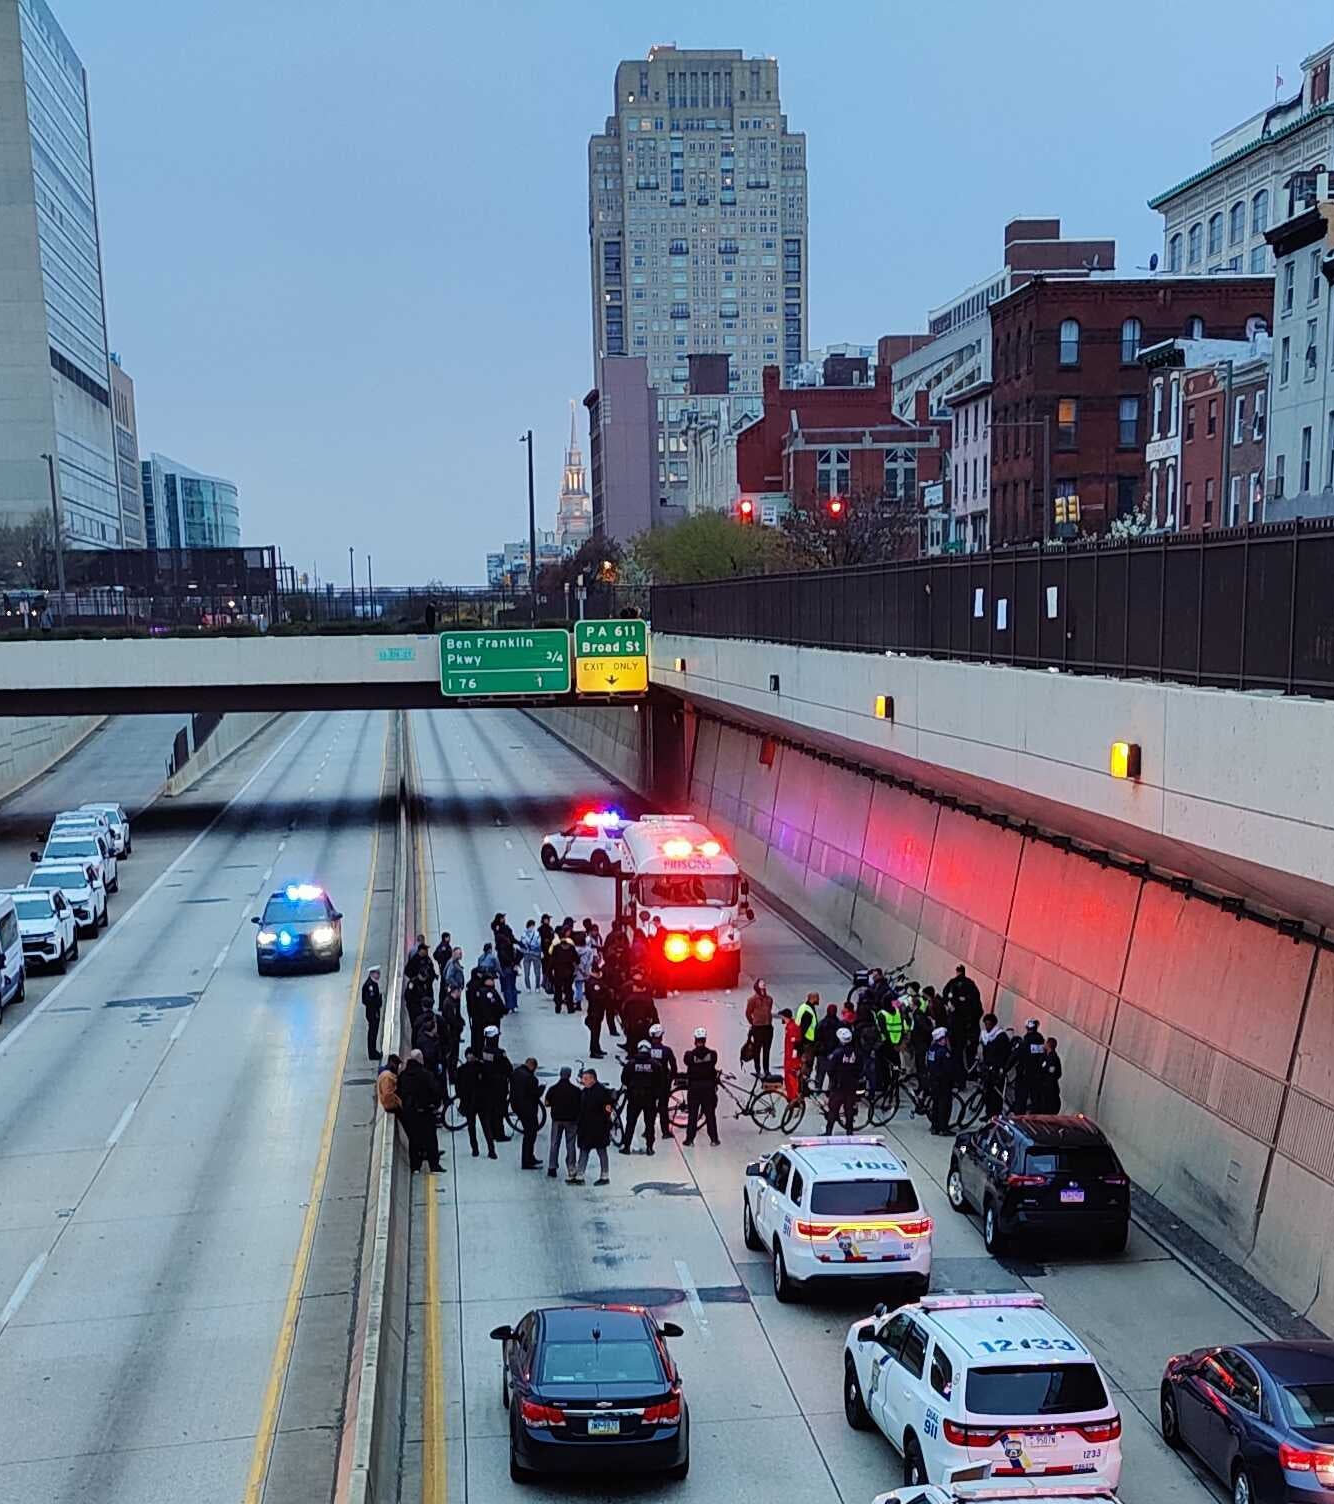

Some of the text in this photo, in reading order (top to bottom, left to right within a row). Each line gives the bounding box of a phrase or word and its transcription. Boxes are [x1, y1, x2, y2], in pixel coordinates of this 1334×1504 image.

[586, 626, 636, 637] PA 611
[446, 638, 534, 649] Ben Franklin
[582, 641, 640, 652] Broad St
[448, 654, 482, 667] Pkwy
[583, 662, 639, 671] EXIT ONLY
[459, 678, 477, 689] 76
[664, 860, 712, 869] PRISONS
[925, 1406, 940, 1424] DIAL
[923, 1418, 939, 1441] 911
